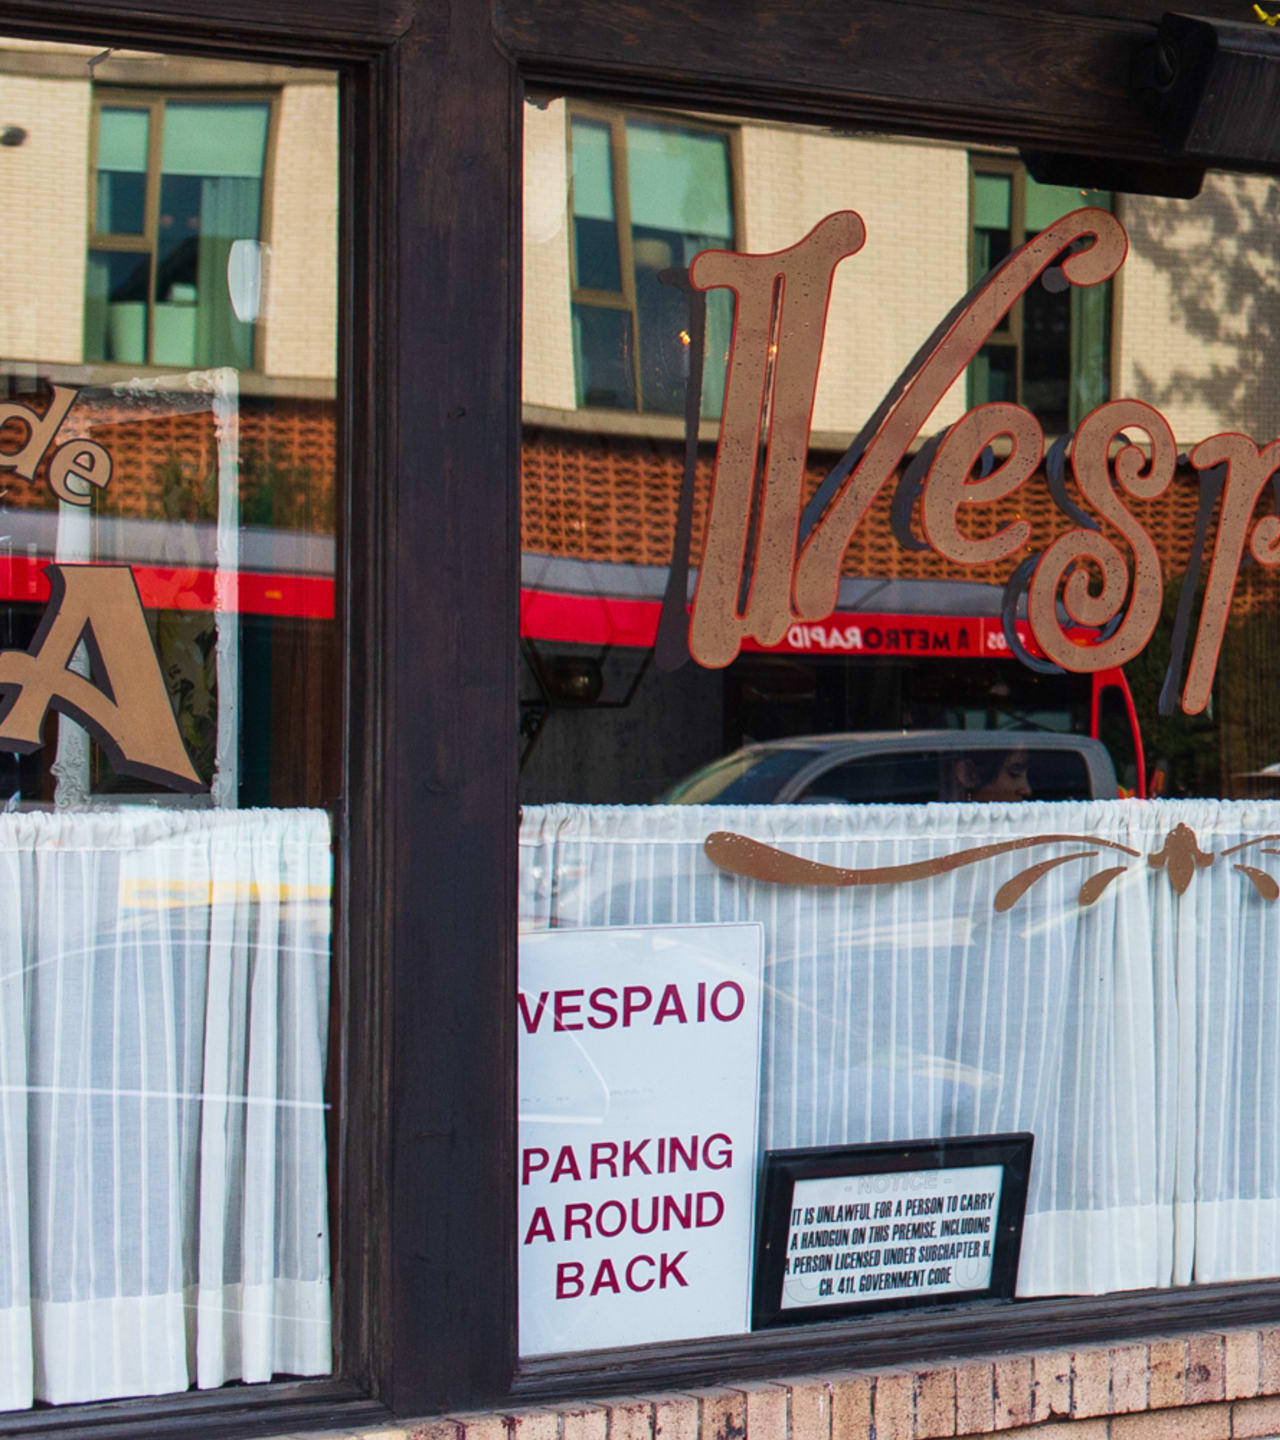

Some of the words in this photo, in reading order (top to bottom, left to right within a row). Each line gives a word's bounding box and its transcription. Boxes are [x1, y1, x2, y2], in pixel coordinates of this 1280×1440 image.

[518, 980, 745, 1034] VESPAIO
[522, 1133, 733, 1185] PARKING
[858, 1171, 938, 1195] NOTICE
[523, 1191, 725, 1245] AROUND
[791, 1208, 803, 1226] IT
[804, 1207, 815, 1225] IS
[816, 1203, 871, 1224] UNLAWFUL
[874, 1200, 893, 1220] FOR
[895, 1200, 902, 1217] A
[905, 1197, 944, 1217] PERSON
[947, 1194, 958, 1213] TO
[960, 1192, 995, 1212] CARRY
[790, 1233, 798, 1250] A
[800, 1229, 850, 1249] HANDGUN
[852, 1227, 866, 1245] ON
[868, 1224, 890, 1243] THIS
[940, 1216, 991, 1237] INCLUDING
[556, 1250, 689, 1300] BACK
[785, 1258, 790, 1275] A
[793, 1254, 833, 1274] PERSON
[835, 1249, 881, 1271] LICENSED
[883, 1246, 916, 1266] UNDER
[918, 1240, 980, 1263] SUBCHAPTER
[859, 1270, 926, 1293] GOVERNMENT
[927, 1266, 952, 1286] CODE
